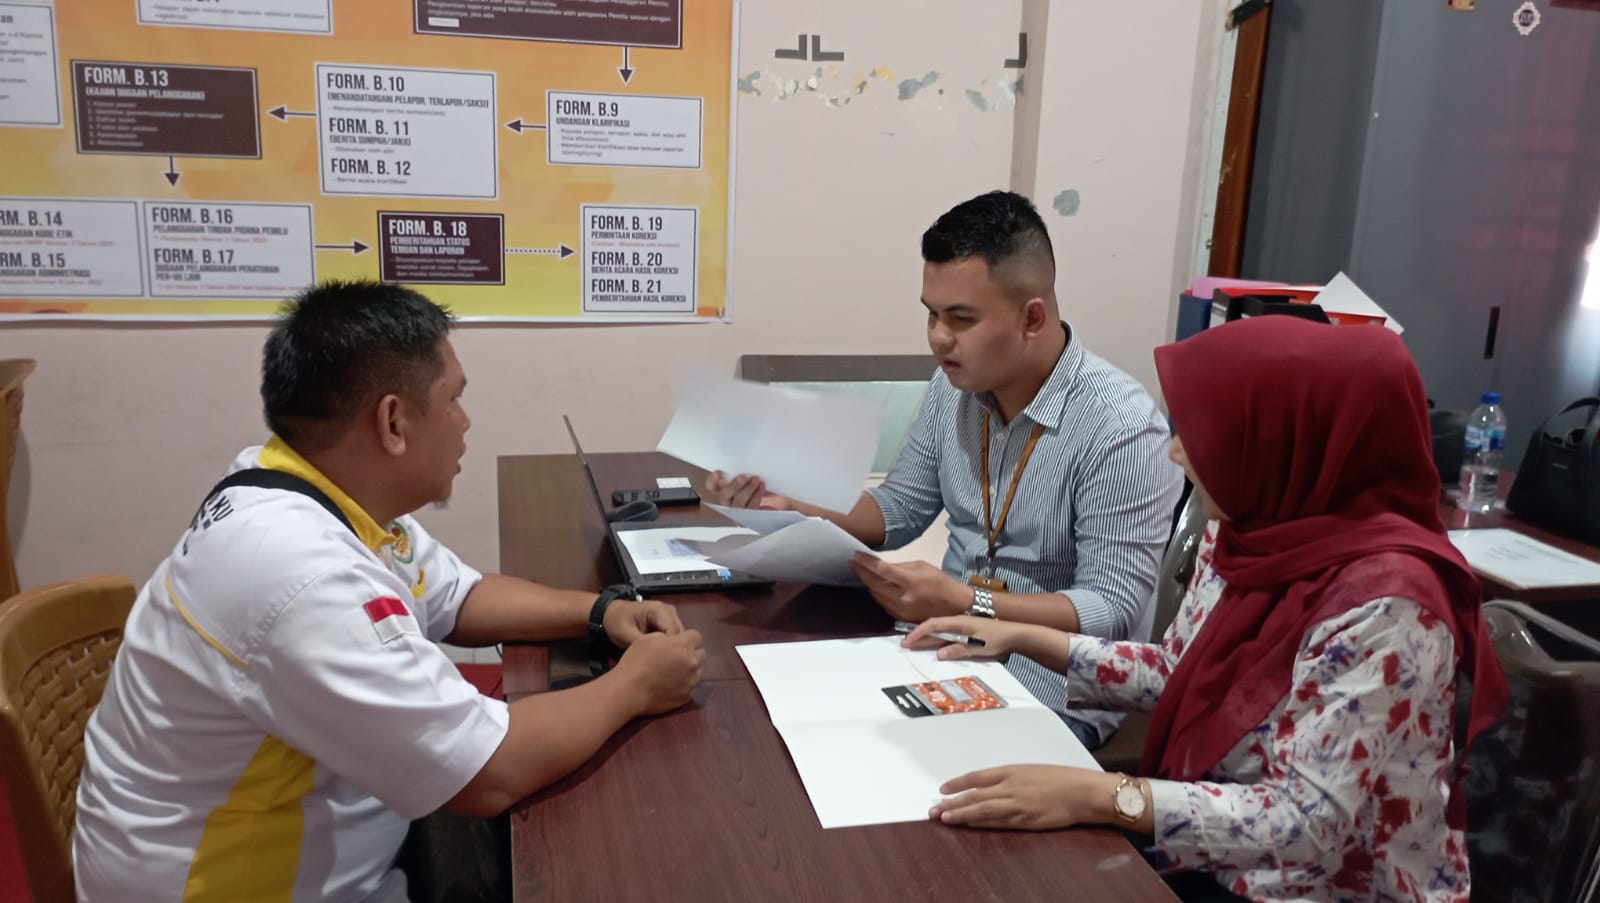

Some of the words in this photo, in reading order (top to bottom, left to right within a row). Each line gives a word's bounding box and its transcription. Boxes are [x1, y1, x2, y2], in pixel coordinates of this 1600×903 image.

[84, 67, 130, 85] FORM.
[134, 69, 168, 86] B.13
[327, 73, 370, 90] FORM.
[374, 75, 405, 92] B.10
[117, 88, 147, 98] DUGAAN
[556, 100, 595, 116] FORM.
[598, 102, 618, 117] B.9
[329, 118, 371, 134] FORM.
[376, 120, 388, 135] B.
[394, 121, 409, 136] 11
[556, 117, 590, 126] UNDANGAN
[592, 118, 630, 128] KLARIFIKASI
[331, 158, 373, 175] FORM.
[377, 160, 390, 175] B.
[394, 160, 411, 176] 12
[28, 210, 62, 226] B.14
[152, 207, 196, 223] FORM.
[200, 208, 233, 224] B.16
[591, 215, 628, 230] FORM.
[632, 216, 643, 231] B.
[648, 217, 662, 231] 19
[262, 227, 288, 235] PEMILU
[389, 219, 430, 236] FORM.
[433, 220, 446, 236] B.
[450, 221, 467, 236] 18
[591, 231, 630, 239] PERMINTAAN
[632, 232, 657, 240] KOREKSI
[446, 237, 470, 246] STATUS
[154, 248, 198, 264] FORM.
[202, 249, 234, 264] B.17
[419, 246, 434, 254] DAN
[434, 246, 465, 255] LAPORAN
[591, 251, 628, 266] FORM.
[632, 252, 643, 266] B.
[647, 252, 662, 266] 20
[32, 252, 65, 268] B.15
[591, 266, 612, 274] BERITA
[614, 266, 634, 274] ACARA
[591, 279, 628, 293] FORM.
[632, 279, 643, 293] B.
[647, 280, 661, 293] 21
[661, 295, 686, 303] KOREKSI
